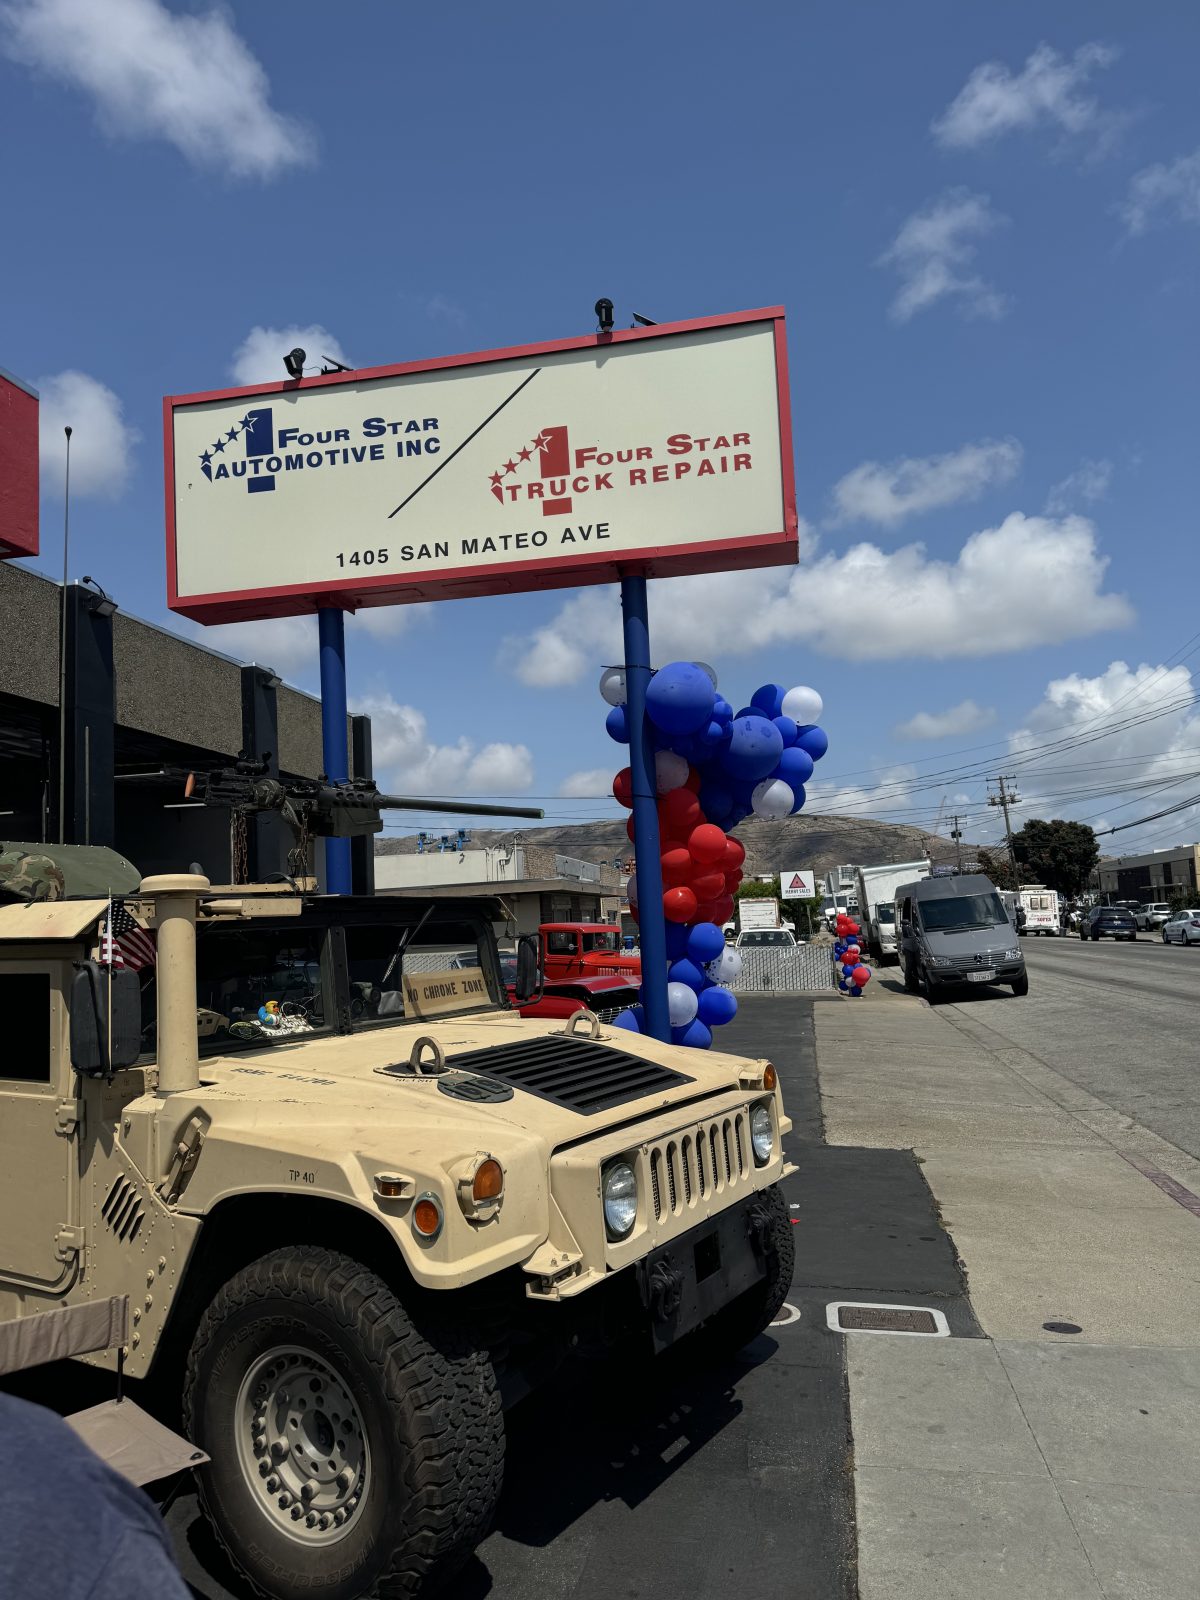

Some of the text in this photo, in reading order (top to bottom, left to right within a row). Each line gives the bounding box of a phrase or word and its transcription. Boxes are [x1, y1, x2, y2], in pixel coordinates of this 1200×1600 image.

[214, 437, 441, 480] AUTOMOTIVE INC
[506, 453, 752, 502] TRUCK REPAIR
[336, 522, 610, 568] 1405 SAN MATEO AVE
[407, 979, 484, 1003] NO CHROME ZONE
[289, 1169, 315, 1184] TP 40
